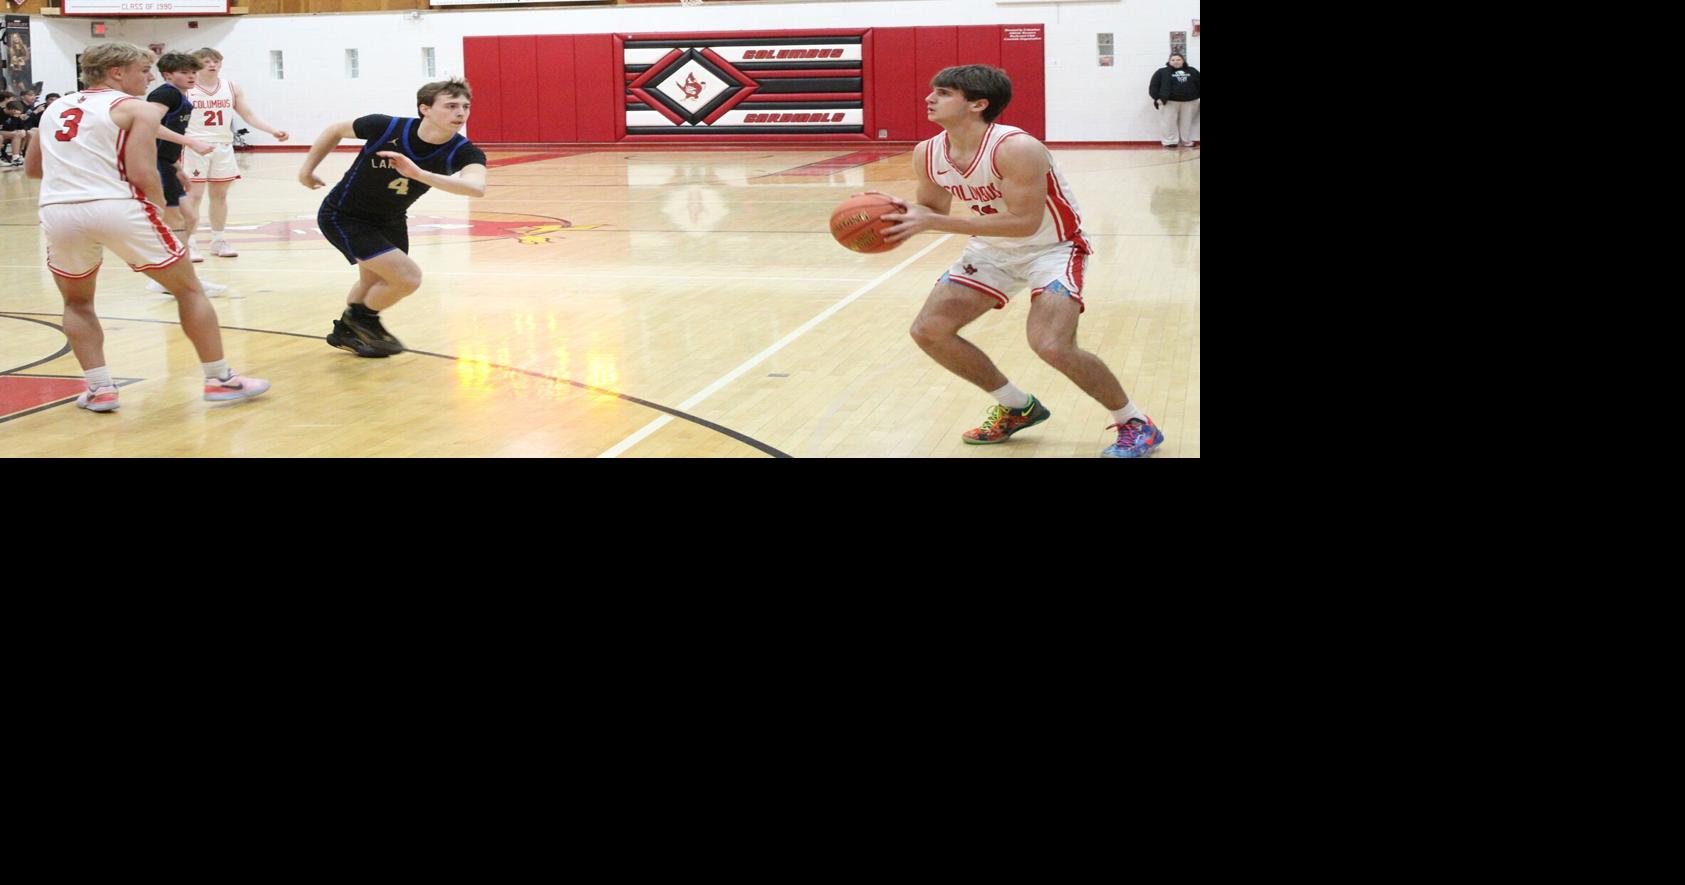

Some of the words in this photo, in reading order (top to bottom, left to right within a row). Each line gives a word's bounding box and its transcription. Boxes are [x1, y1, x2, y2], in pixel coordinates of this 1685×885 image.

[742, 48, 844, 60] COLUMBUS
[192, 98, 231, 109] COLUMBUS
[54, 107, 84, 142] 3
[203, 110, 223, 126] 21
[387, 177, 409, 195] 4
